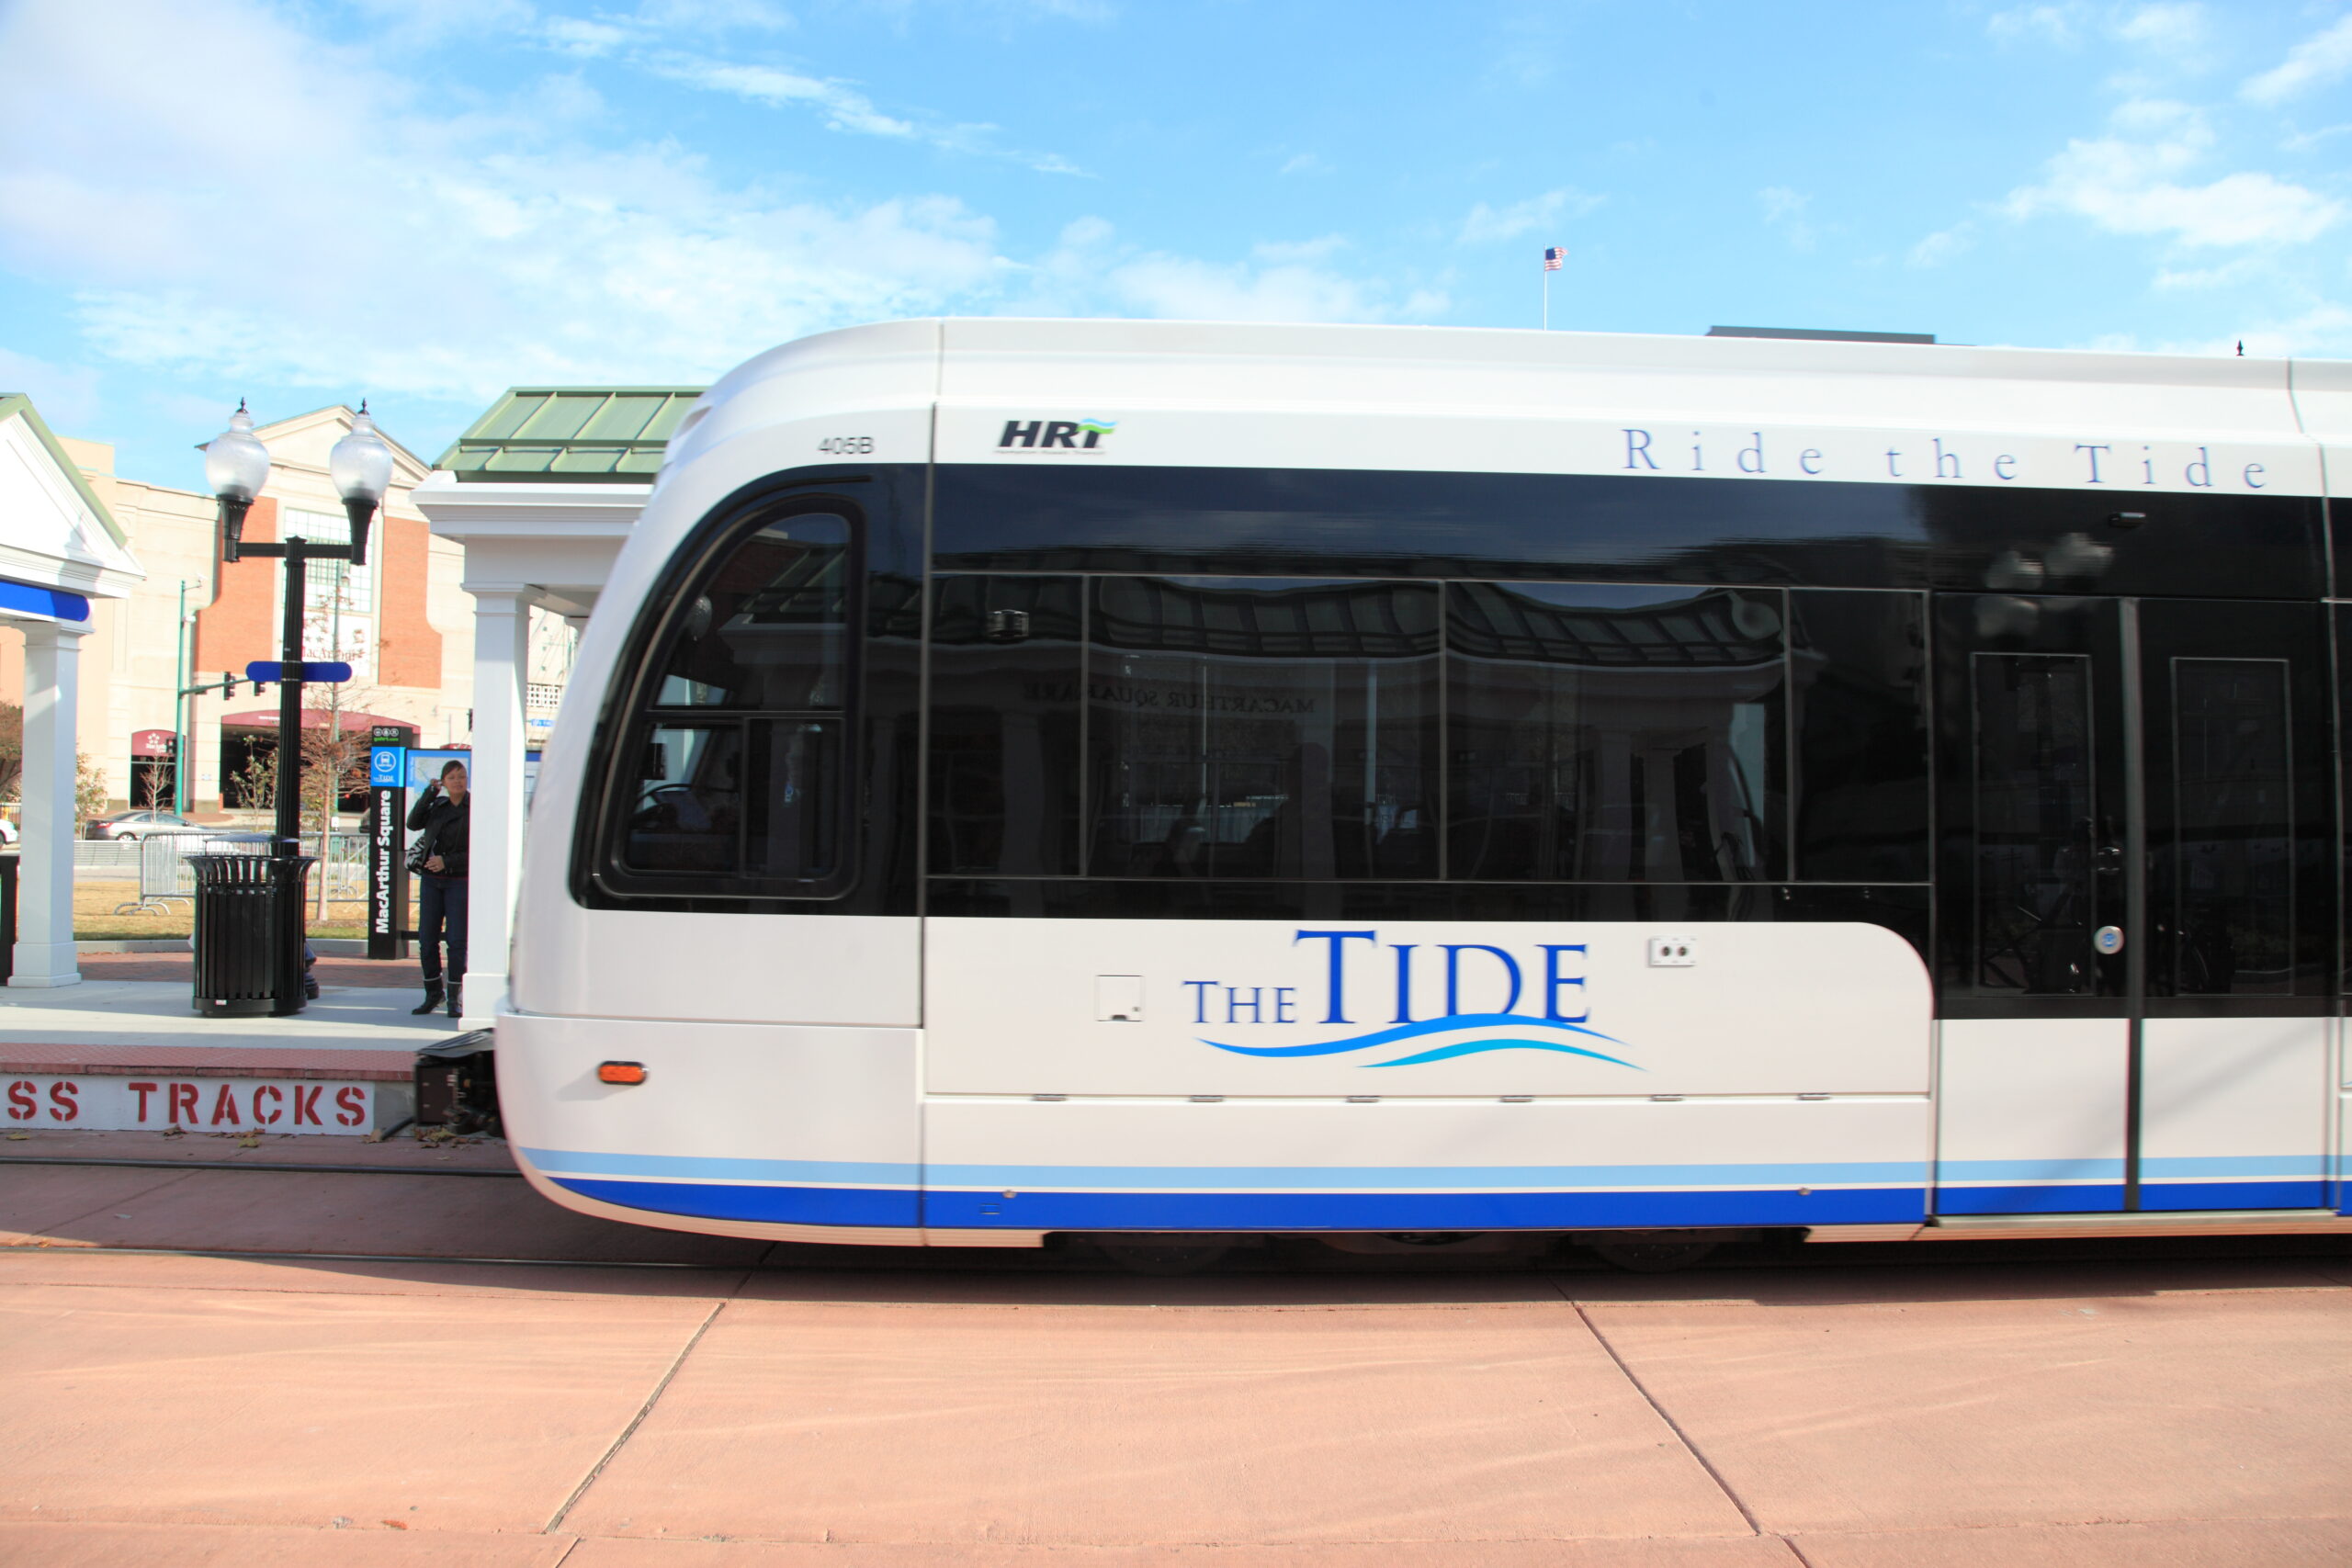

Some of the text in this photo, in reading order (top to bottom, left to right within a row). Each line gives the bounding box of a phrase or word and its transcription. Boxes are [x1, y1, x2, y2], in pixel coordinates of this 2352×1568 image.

[817, 435, 874, 456] 405B
[998, 420, 1102, 449] HRT
[1623, 428, 2267, 489] Ride the Tide
[376, 790, 393, 934] MacArthur Square
[1295, 929, 1590, 1025] TIDE
[129, 1082, 366, 1125] TRACKS
